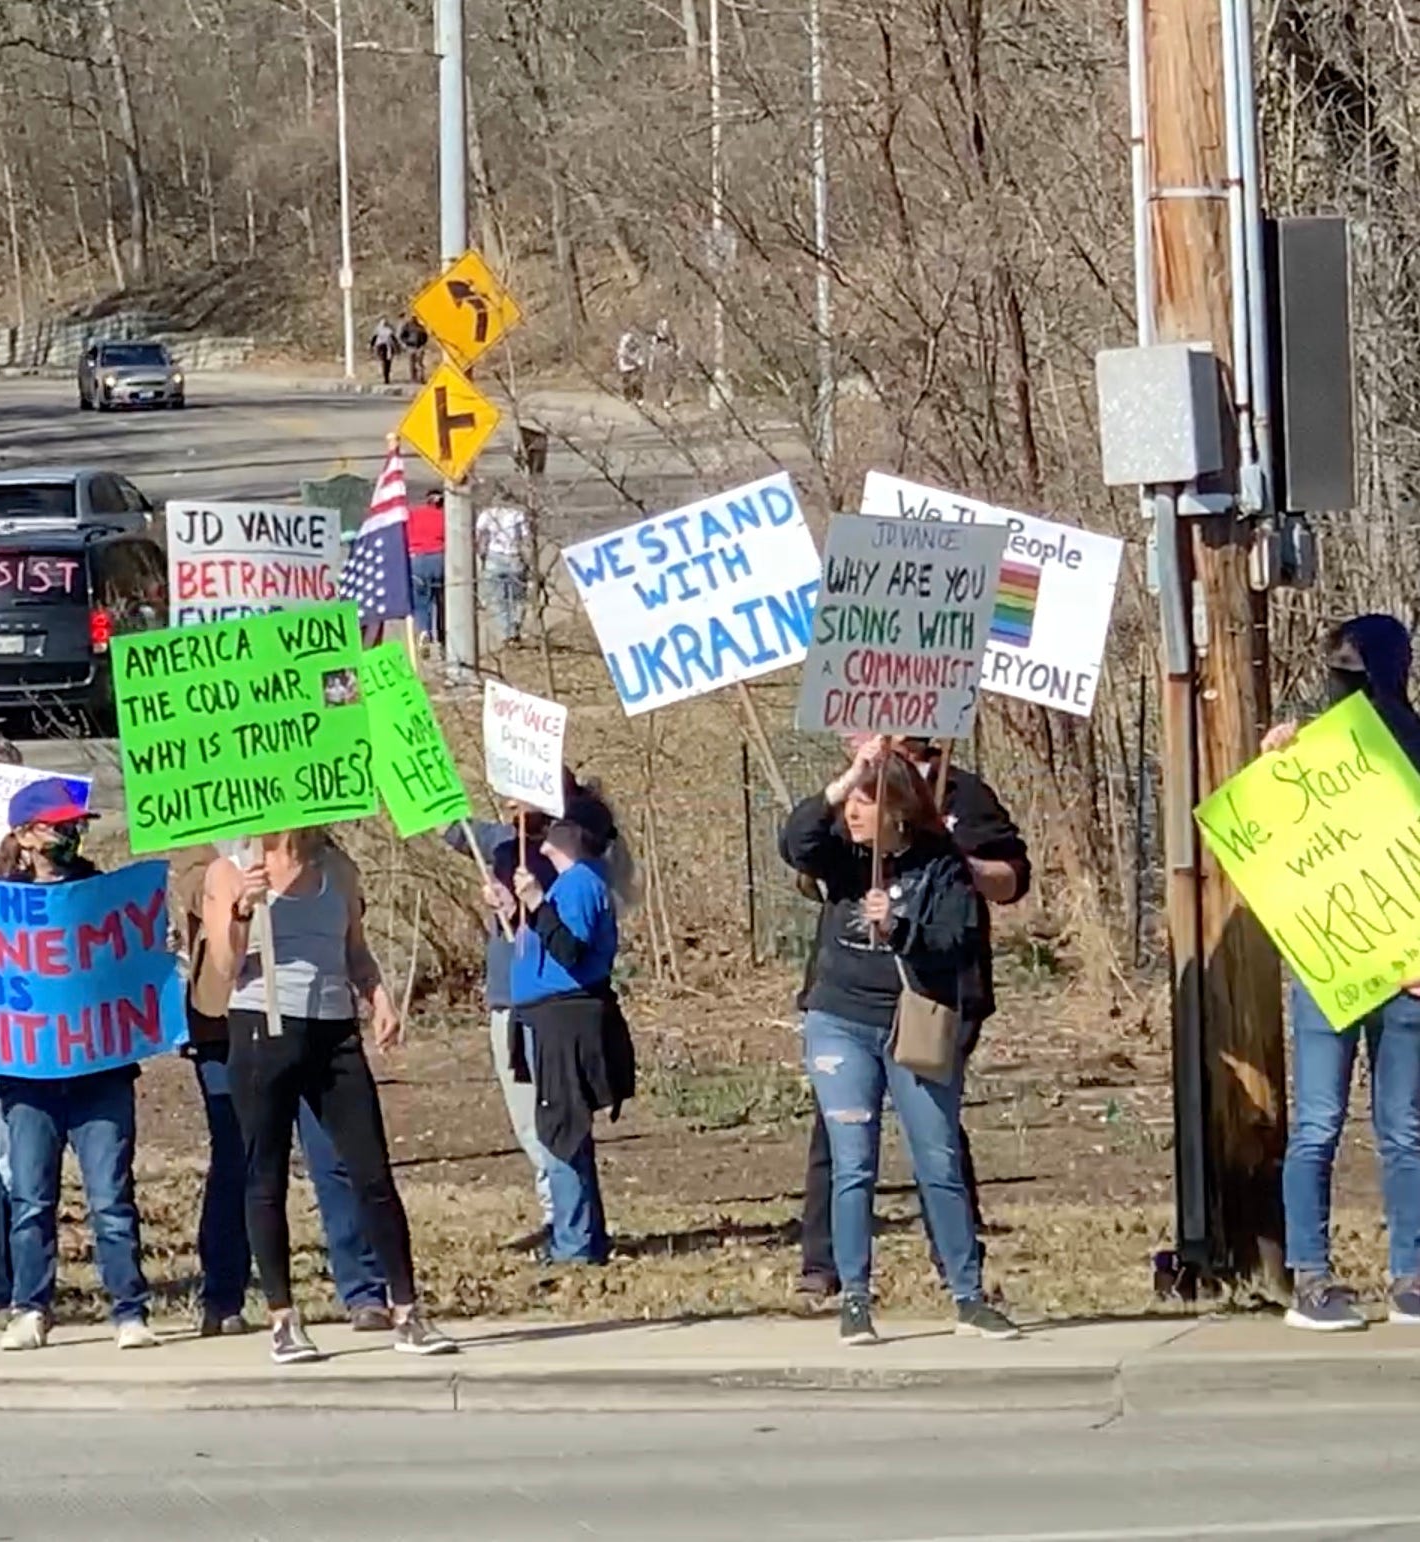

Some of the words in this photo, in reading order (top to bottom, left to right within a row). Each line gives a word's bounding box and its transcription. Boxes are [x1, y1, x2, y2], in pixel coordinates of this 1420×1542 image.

[176, 510, 223, 546] JD
[237, 512, 327, 548] VANCE
[567, 537, 635, 588] WE
[637, 486, 794, 564] STAND
[177, 560, 336, 601] BETRAYING
[633, 542, 752, 610] WITH
[826, 555, 880, 597] WHY
[886, 560, 933, 598] ARE
[944, 564, 987, 604] YOU
[125, 628, 253, 680] AMERICA
[277, 614, 348, 652] WON
[816, 604, 902, 646] SIDING
[918, 610, 975, 650] WITH
[122, 691, 176, 727] THE
[186, 679, 240, 715] COLD
[249, 668, 312, 704] WAR.
[821, 660, 833, 676] A
[844, 649, 974, 690] COMMUNIST
[824, 688, 939, 731] DICTATOR
[127, 739, 187, 775] WHY
[198, 731, 221, 764] IS
[232, 712, 321, 759] TRUMP
[136, 777, 285, 829] SWITCHING
[295, 738, 375, 802] SIDES?
[1198, 791, 1273, 862] We
[1272, 728, 1381, 824] Stand
[1286, 822, 1363, 878] with
